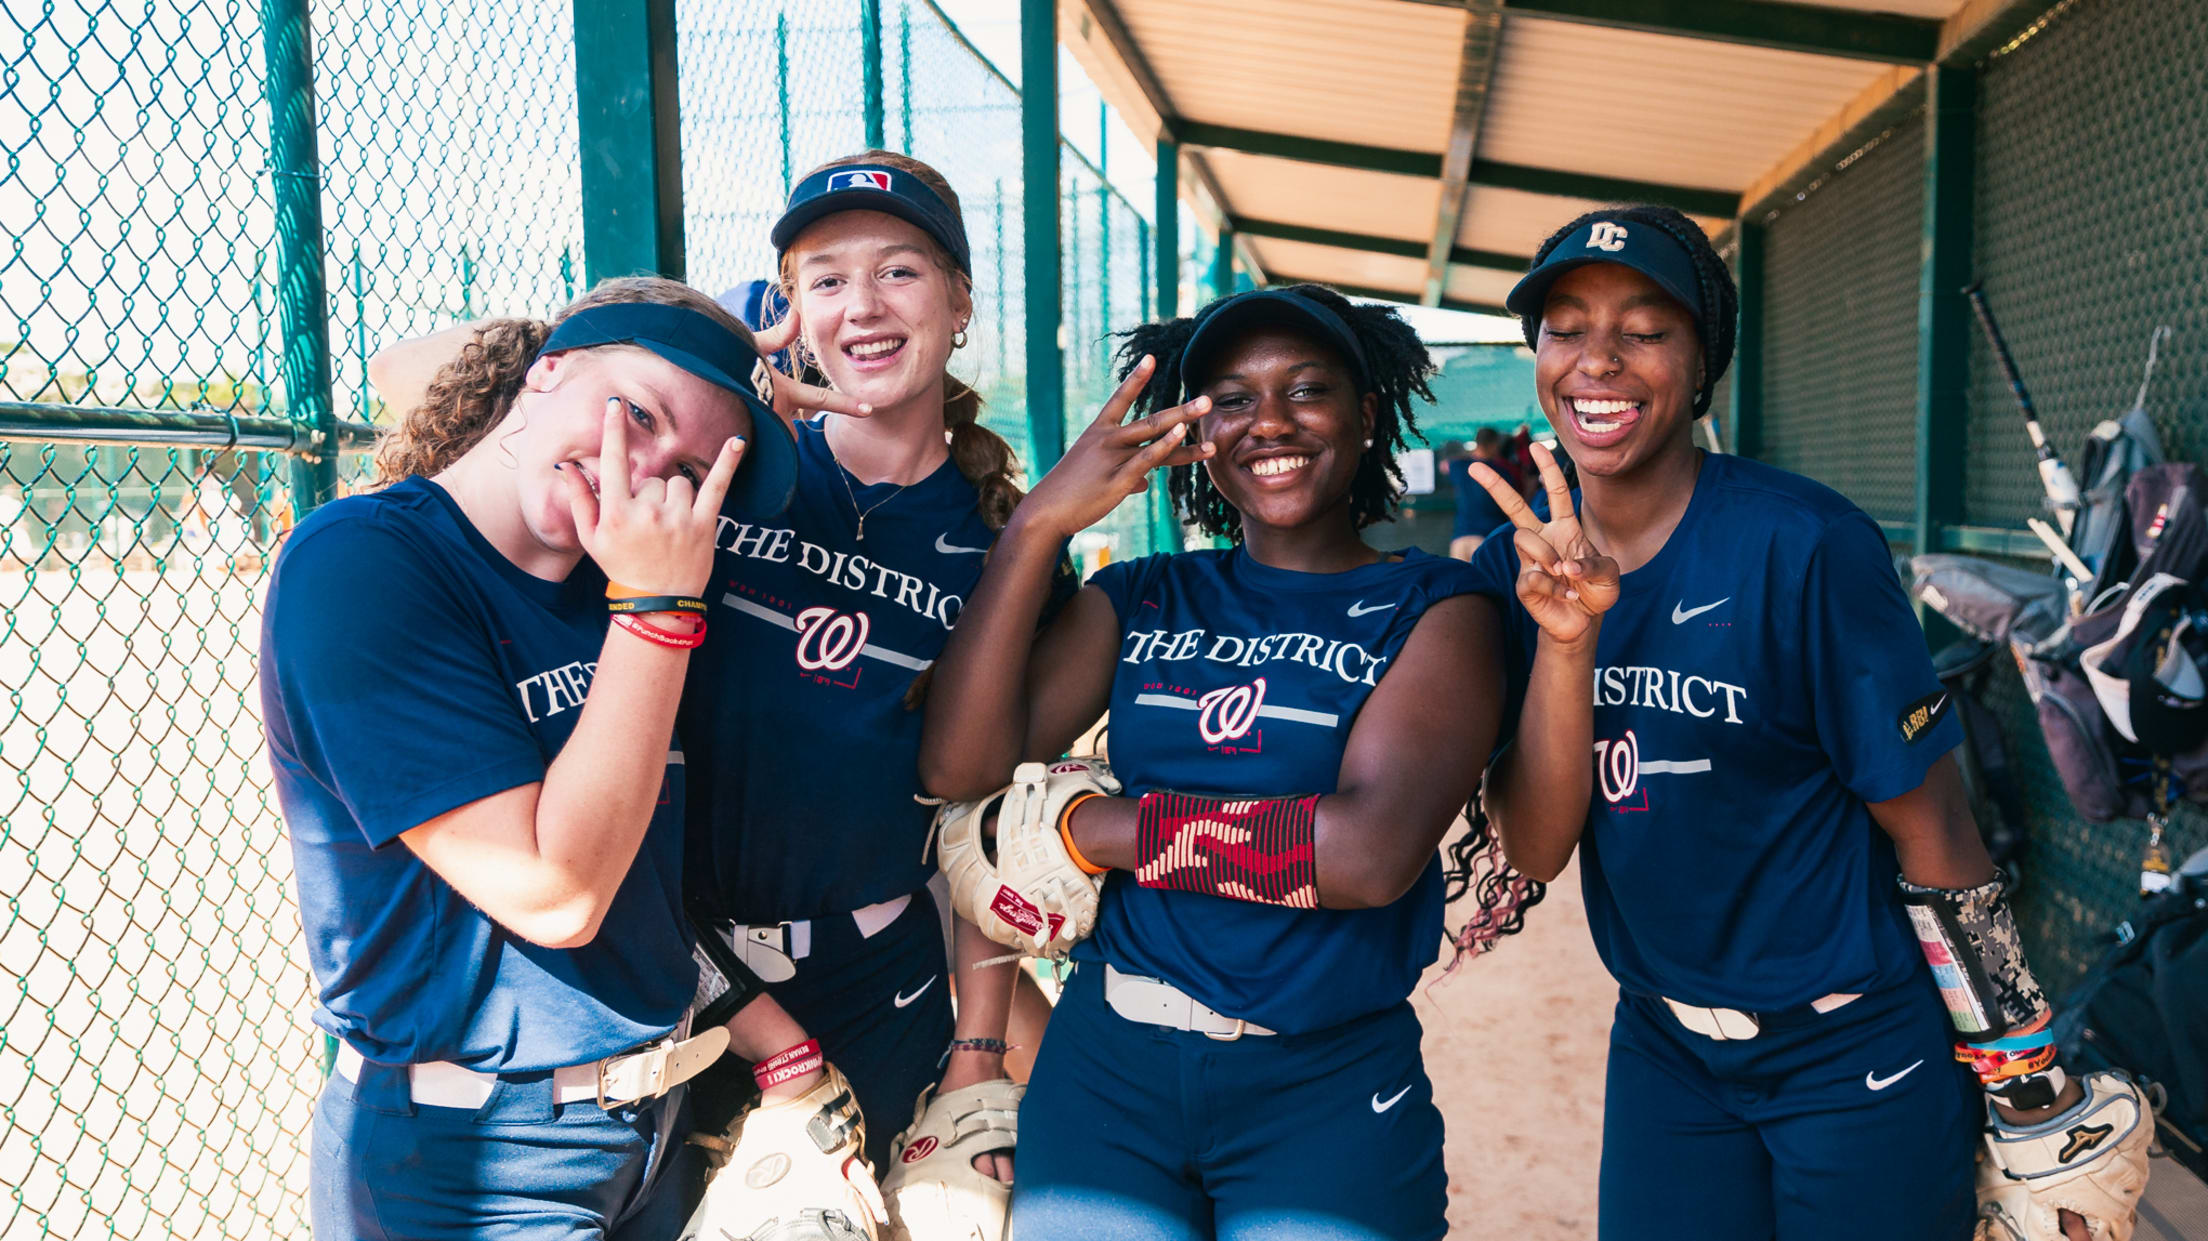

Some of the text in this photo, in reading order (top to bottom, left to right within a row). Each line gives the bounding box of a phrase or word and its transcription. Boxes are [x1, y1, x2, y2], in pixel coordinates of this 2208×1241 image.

[1585, 221, 1628, 252] DC
[714, 515, 796, 563] THE
[797, 541, 964, 631] DISTRIC
[794, 606, 871, 671] W
[1123, 629, 1387, 687] THE DISTRICT
[516, 660, 588, 724] THE
[1196, 676, 1267, 745] W
[1593, 666, 1747, 724] ISTRICT
[1909, 705, 1929, 731] RBI
